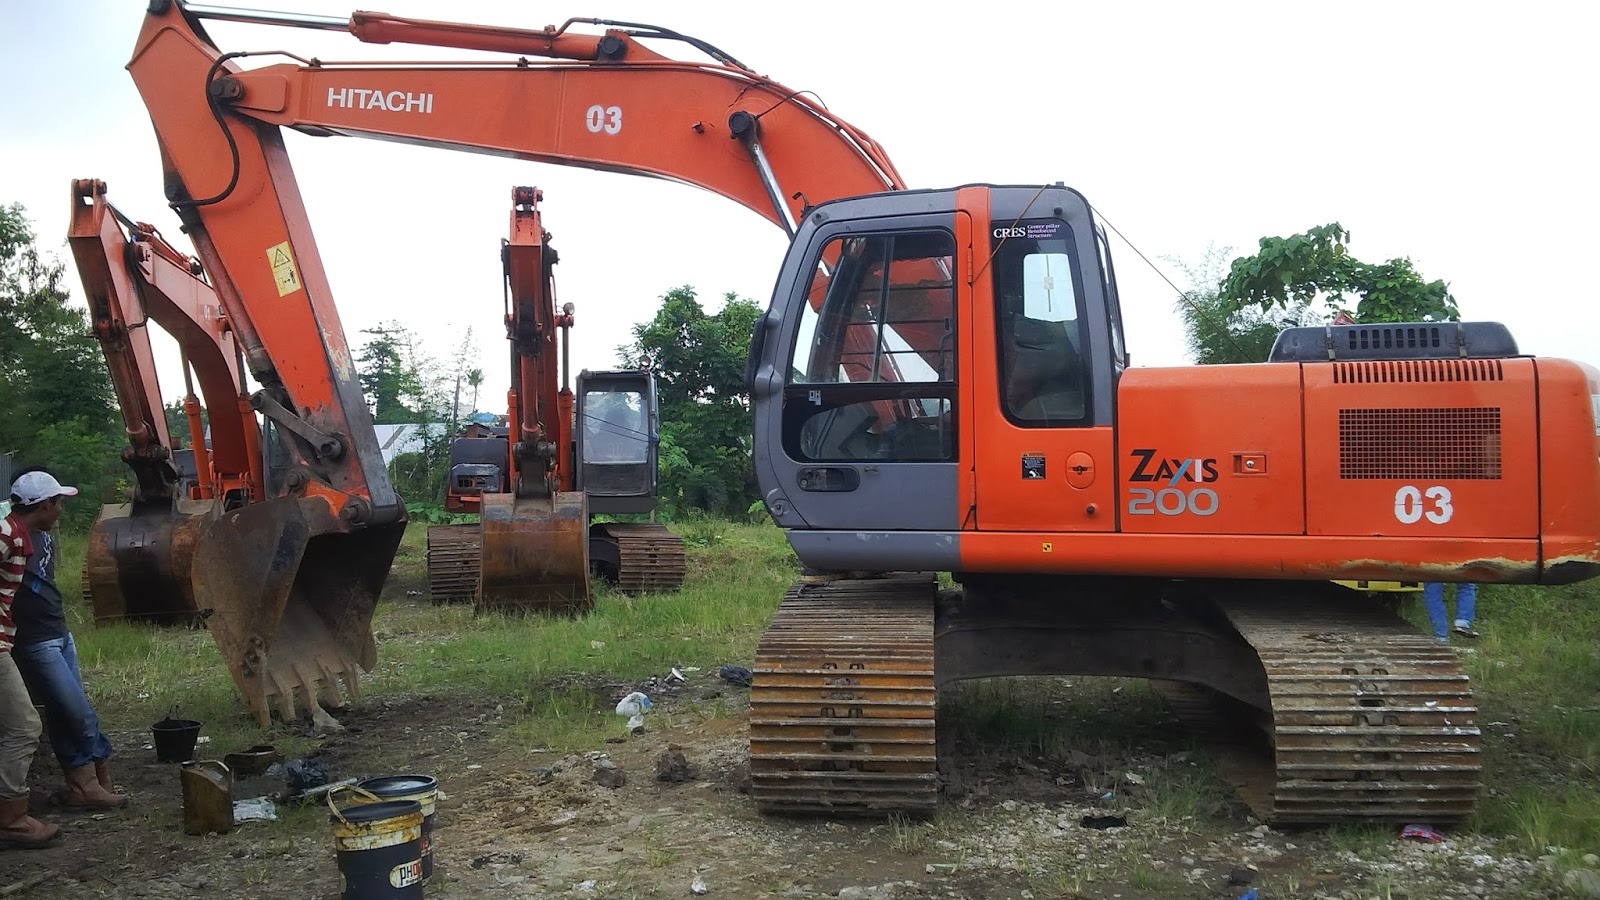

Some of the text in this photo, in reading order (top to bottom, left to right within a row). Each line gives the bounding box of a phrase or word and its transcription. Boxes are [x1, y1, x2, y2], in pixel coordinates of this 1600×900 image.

[327, 87, 434, 114] HITACHI
[586, 104, 623, 135] 03
[993, 226, 1026, 239] CRES
[1128, 449, 1219, 486] ZAXIS
[1128, 488, 1219, 516] 200
[1394, 485, 1454, 525] 03
